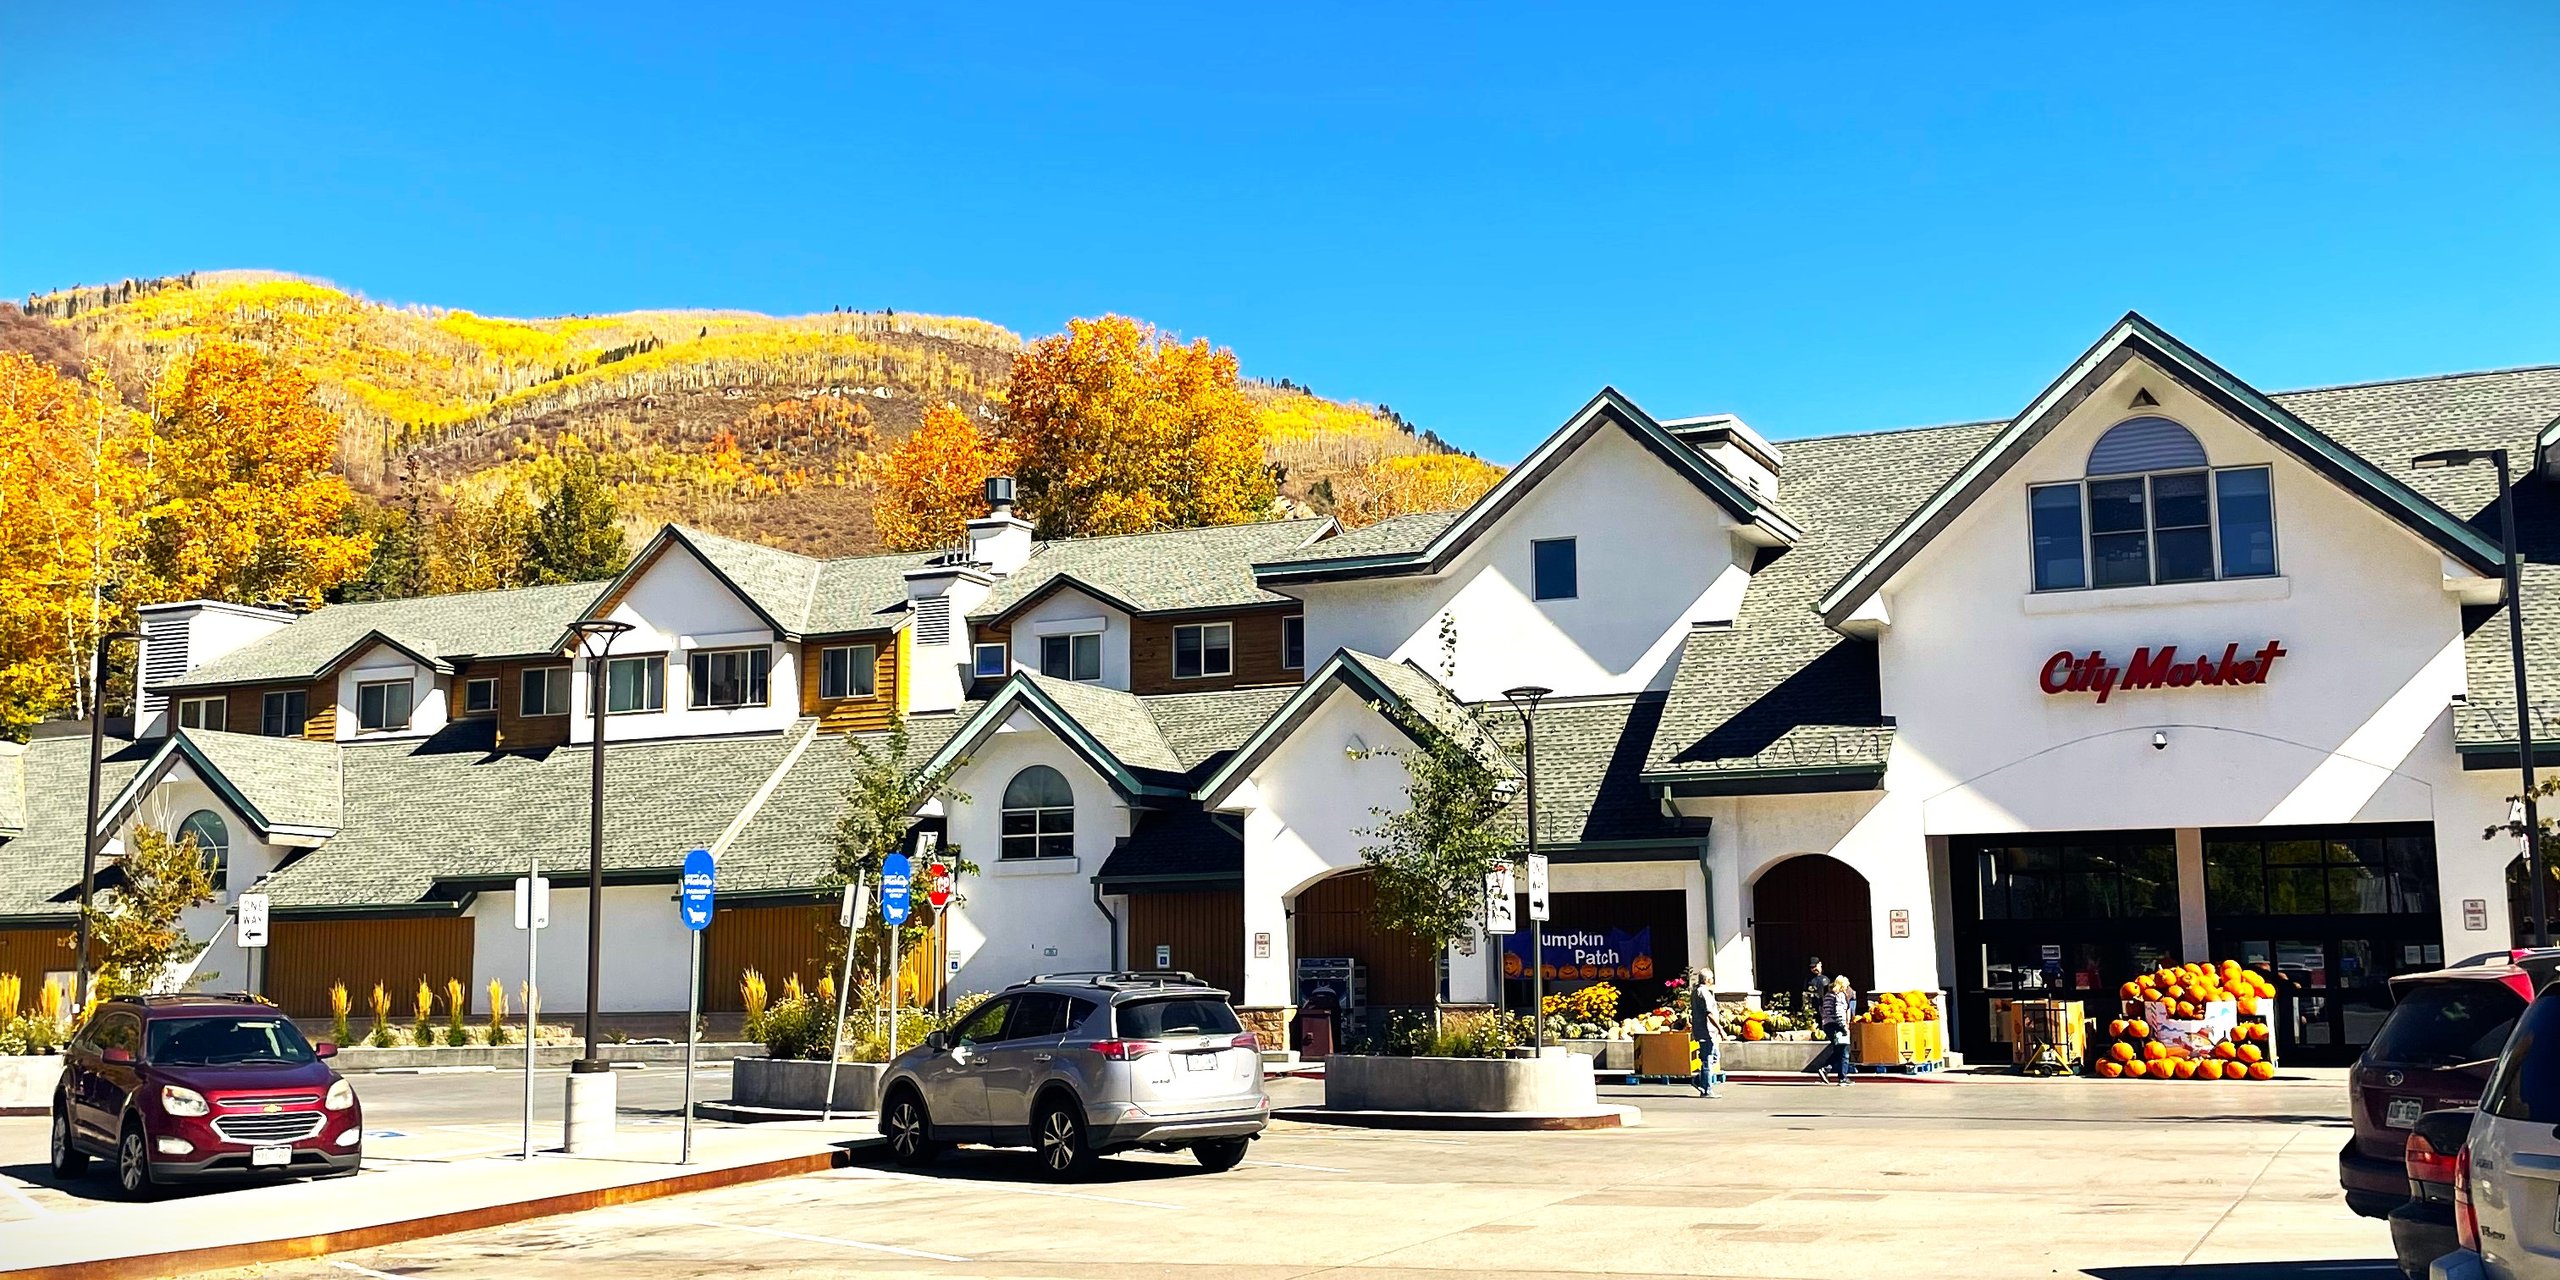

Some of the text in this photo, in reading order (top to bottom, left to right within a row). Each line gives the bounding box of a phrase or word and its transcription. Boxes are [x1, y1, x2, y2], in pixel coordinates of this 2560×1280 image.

[2040, 640, 2288, 704] City Market
[928, 875, 951, 894] TOP
[243, 900, 263, 912] ONE
[243, 915, 263, 925] WAY
[1540, 930, 1604, 950] umpkin
[1574, 948, 1620, 966] Patch
